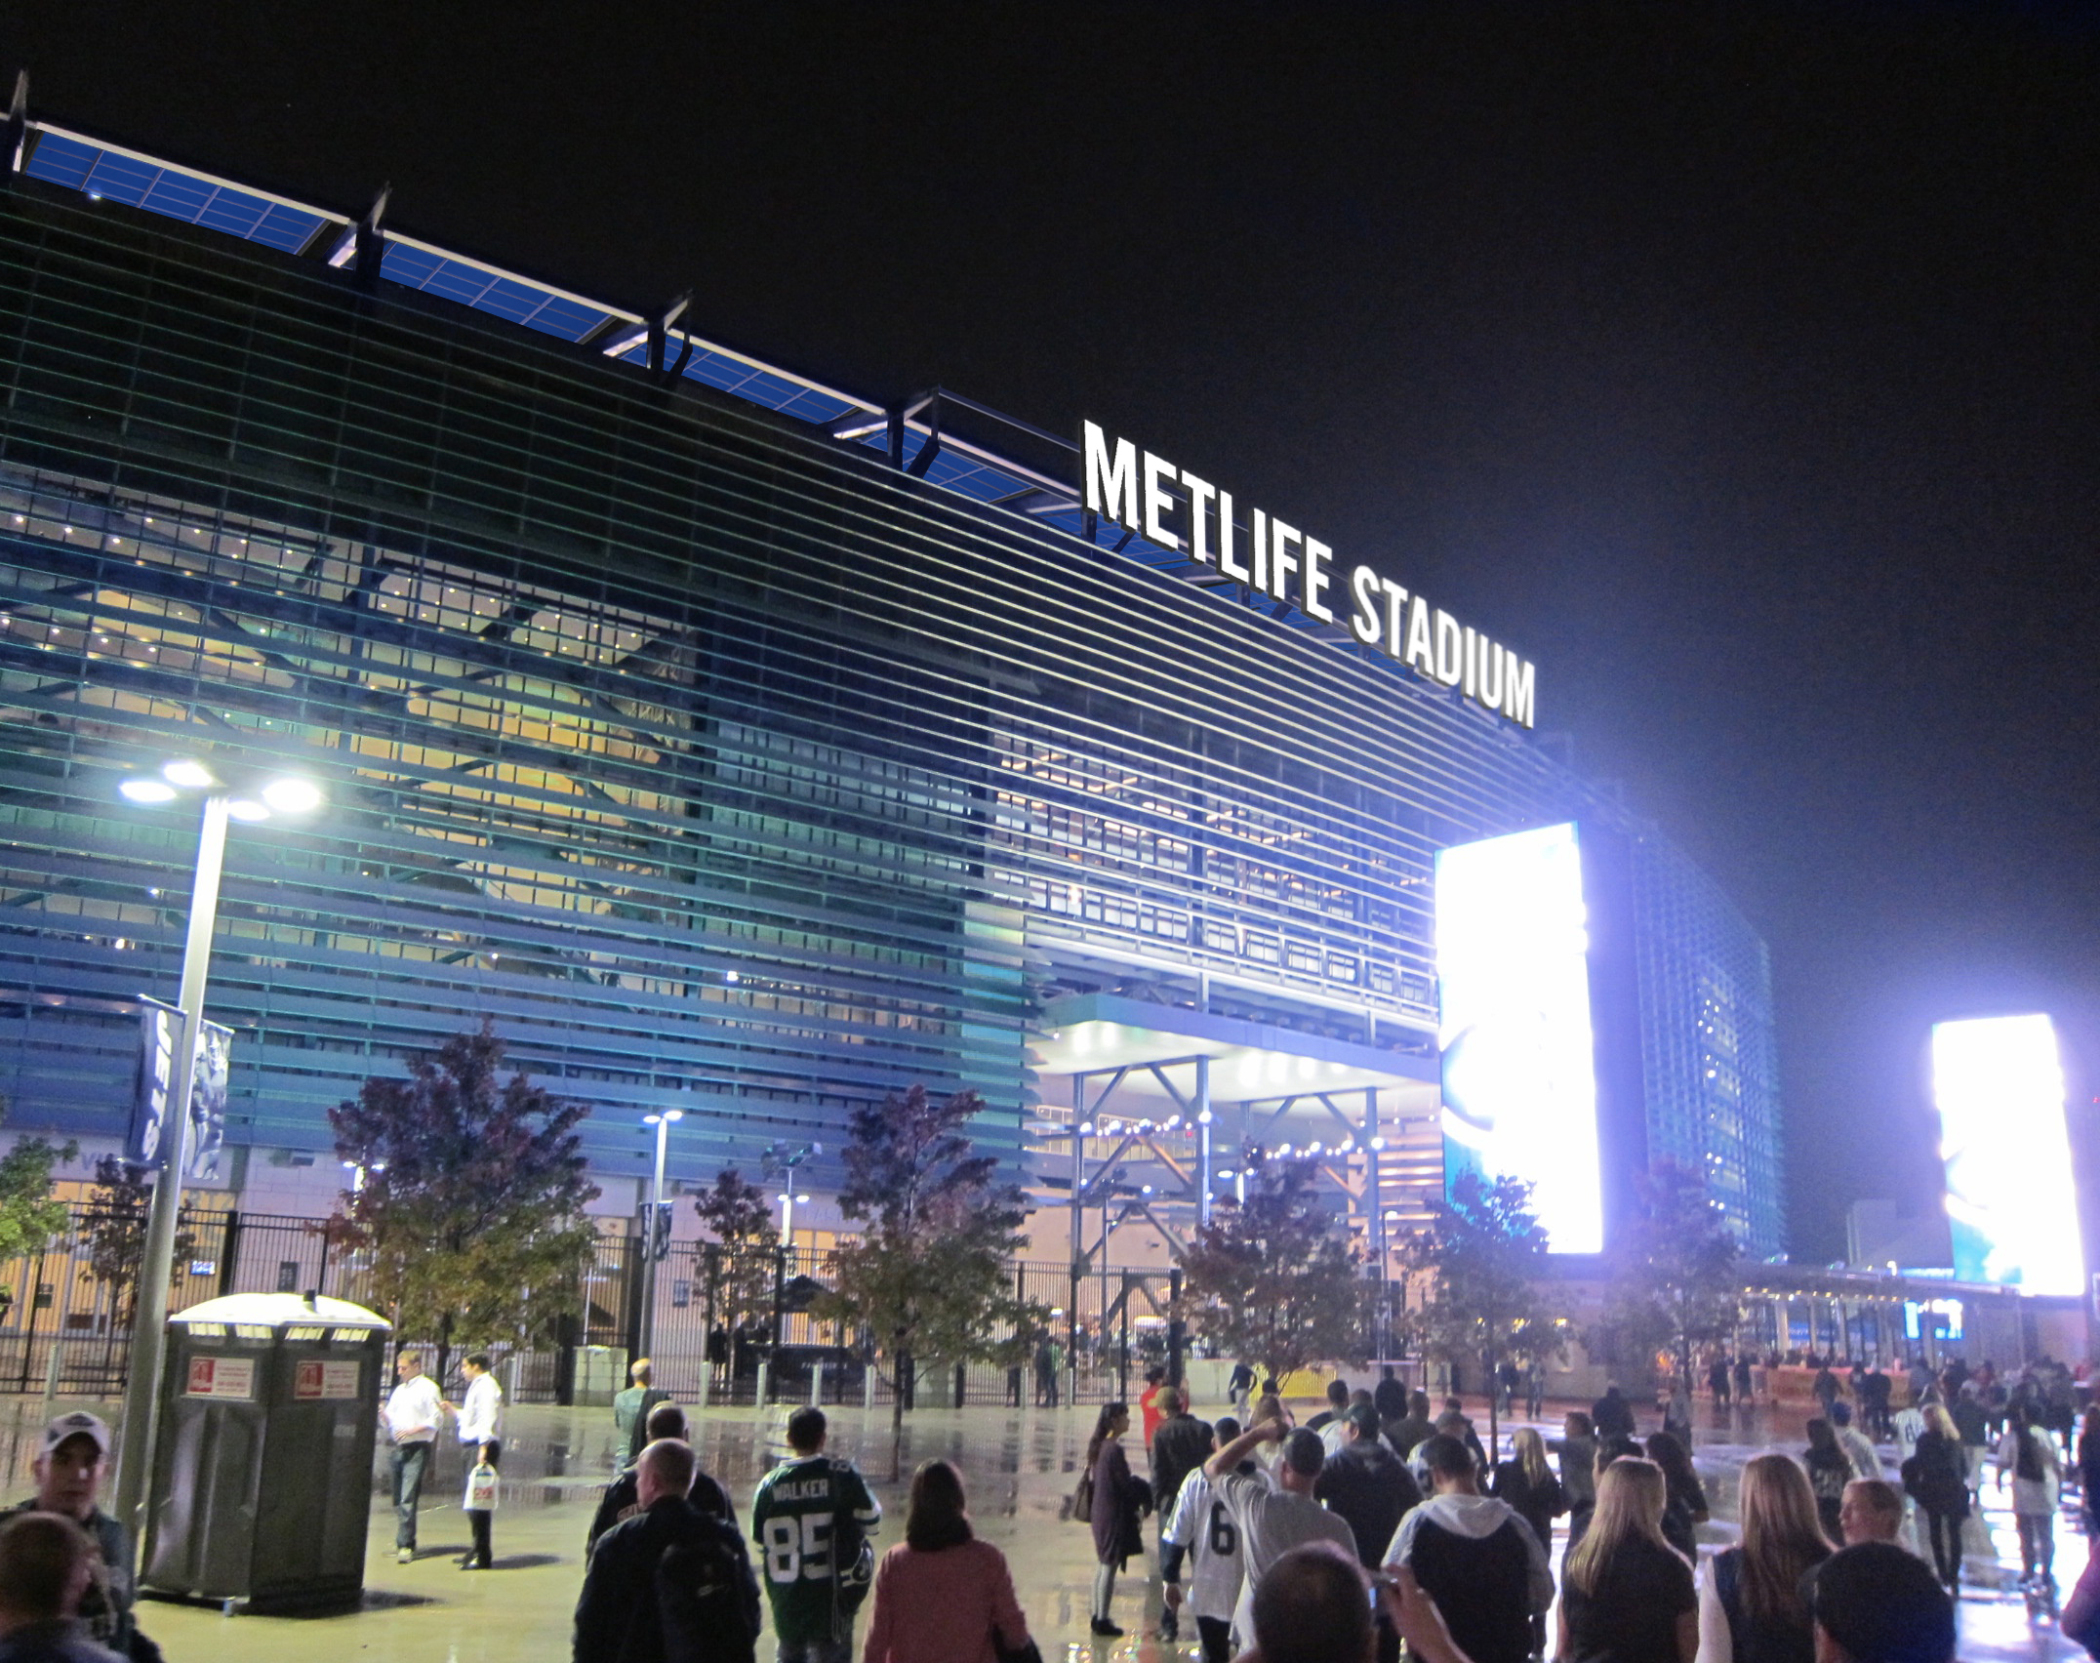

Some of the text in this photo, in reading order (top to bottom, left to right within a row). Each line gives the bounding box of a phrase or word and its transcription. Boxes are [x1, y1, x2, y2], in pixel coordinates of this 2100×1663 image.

[1081, 419, 1535, 729] METLIFE STADIUM
[142, 1009, 172, 1162] JETS
[772, 1478, 829, 1502] WALKER
[763, 1511, 835, 1583] 85
[1210, 1500, 1236, 1556] 6
